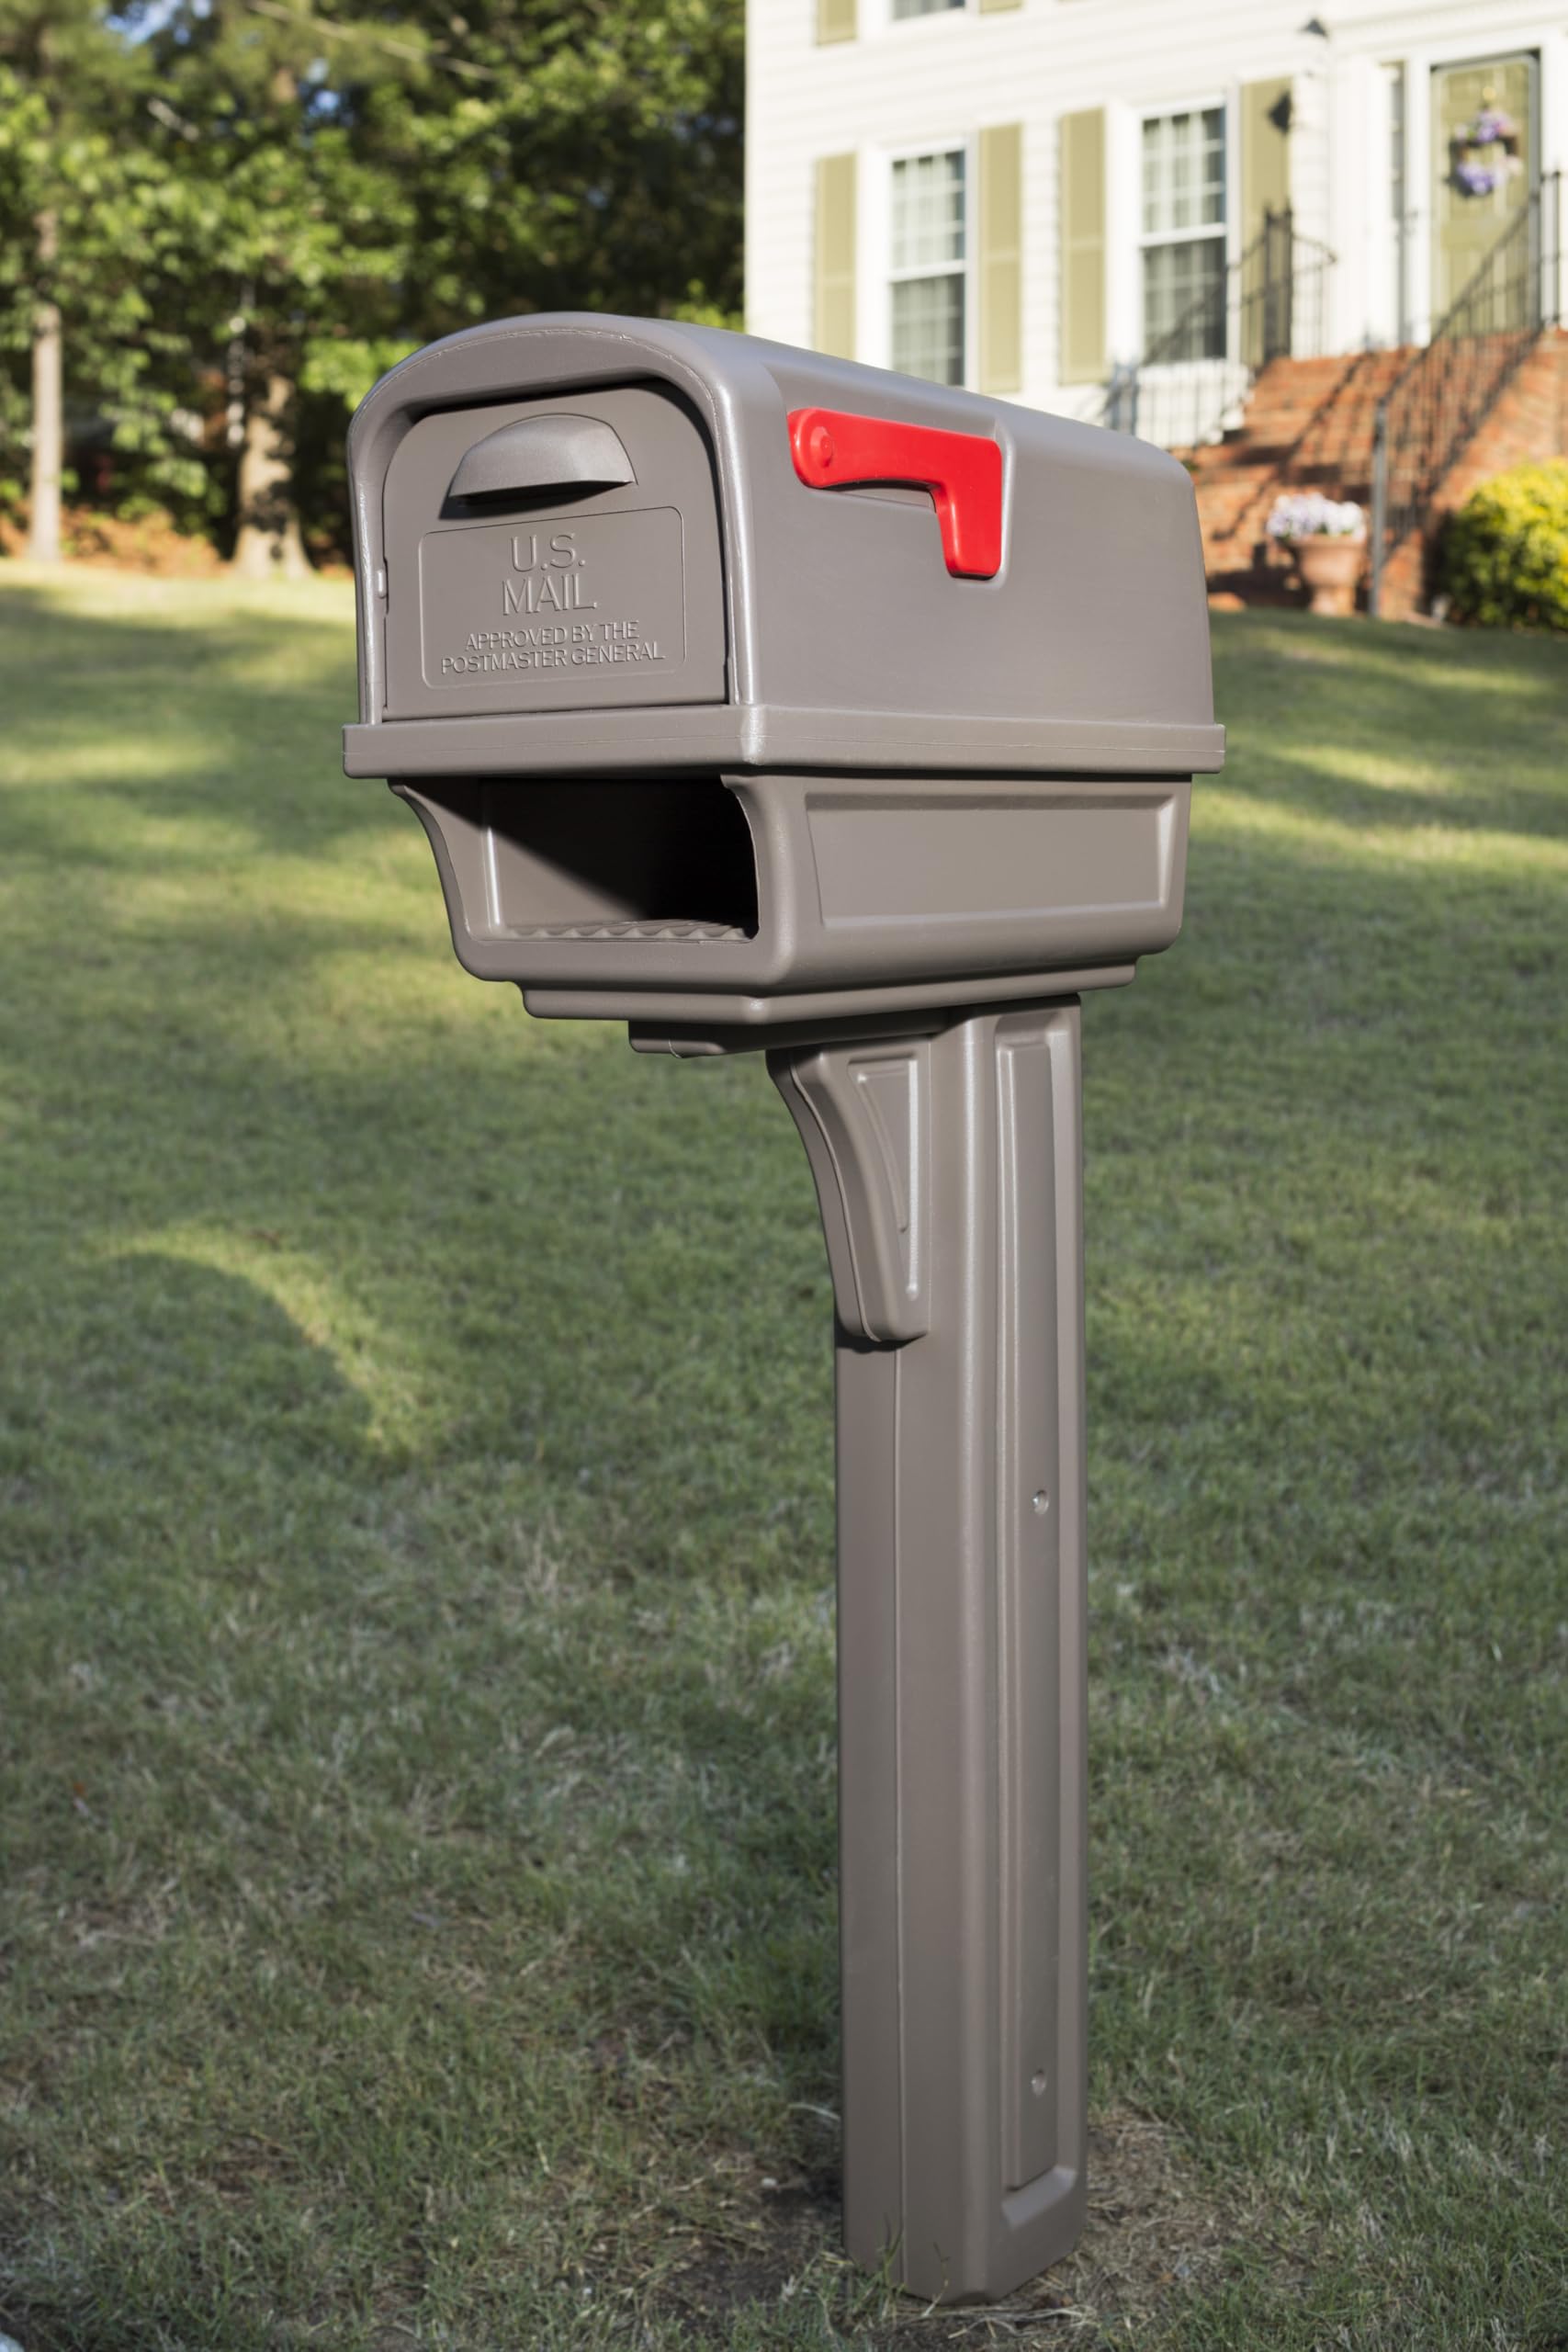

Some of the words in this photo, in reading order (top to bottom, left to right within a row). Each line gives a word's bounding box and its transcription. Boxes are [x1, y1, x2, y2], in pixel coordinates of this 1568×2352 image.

[511, 533, 586, 572] U.S.
[465, 627, 569, 651] APPROVED
[571, 624, 596, 643] BY
[599, 619, 640, 641] THE
[441, 649, 568, 675] POSTMASTER
[570, 641, 667, 665] GENERAL
